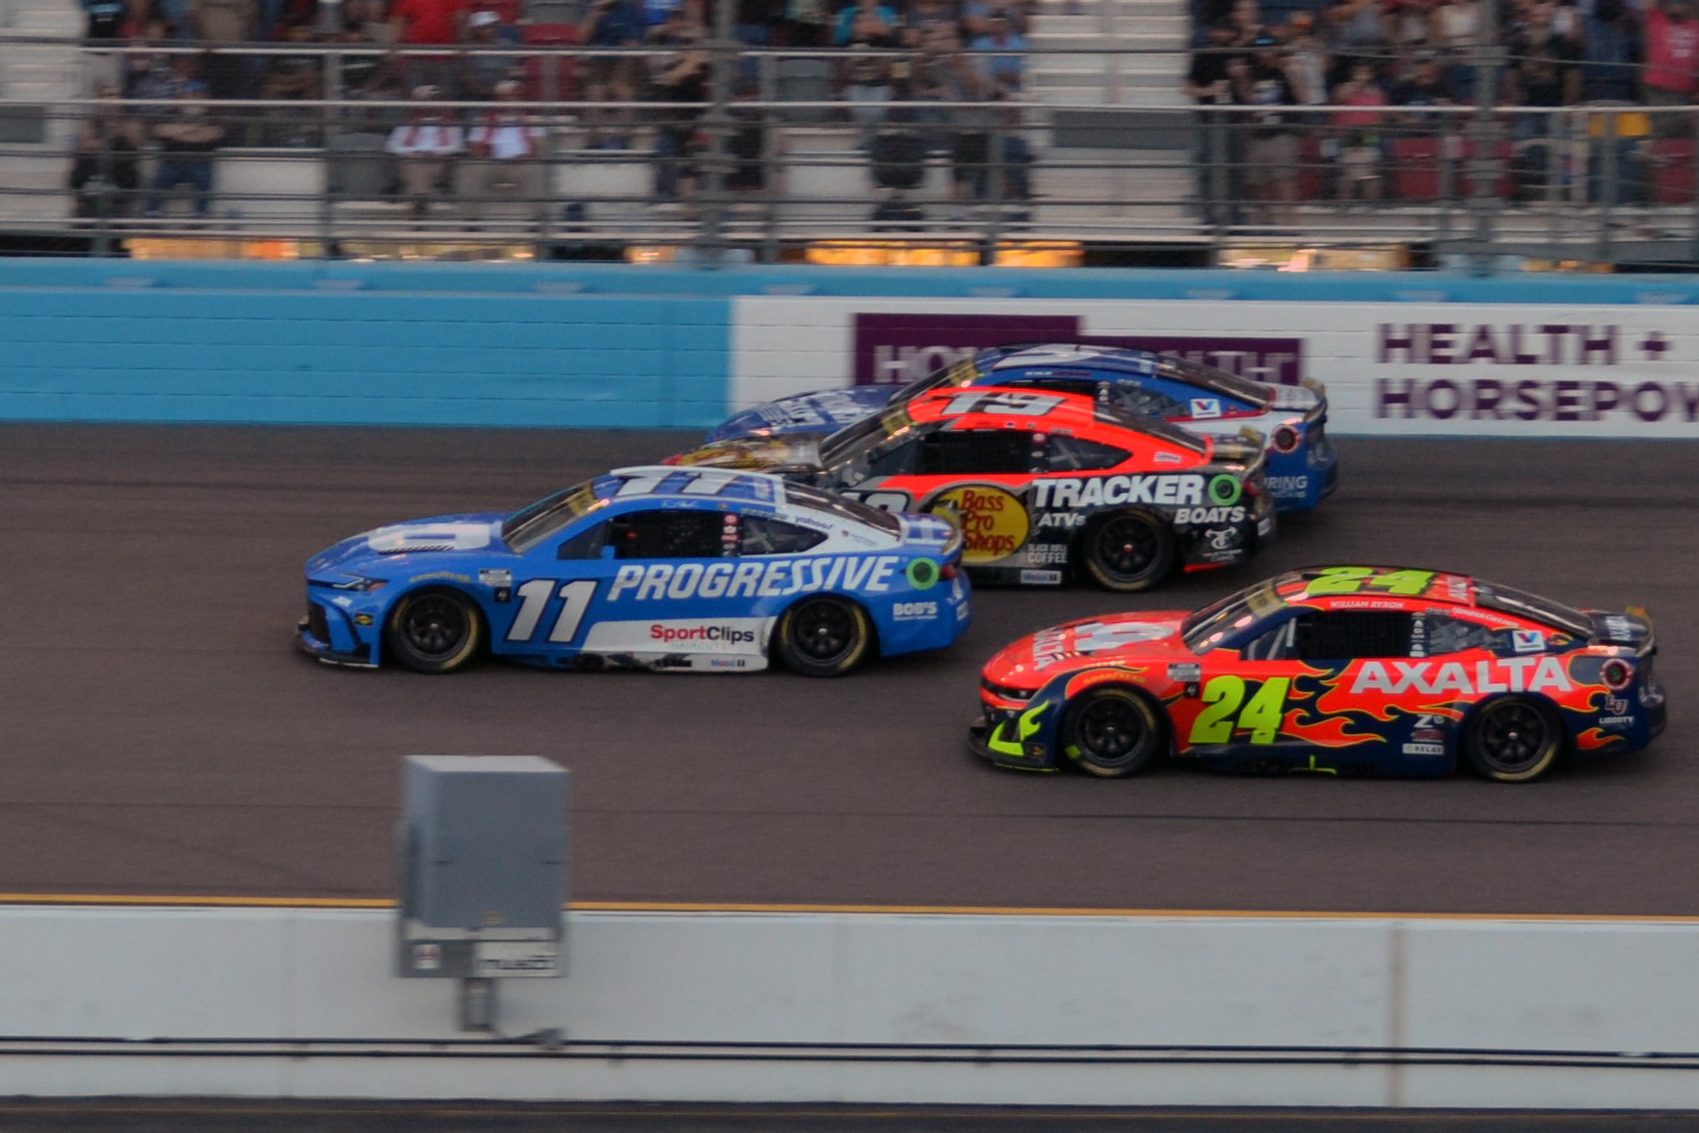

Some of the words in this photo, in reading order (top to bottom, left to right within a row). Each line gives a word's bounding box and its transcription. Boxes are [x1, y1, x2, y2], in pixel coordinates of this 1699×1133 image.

[1375, 323, 1620, 365] HEALTH
[960, 490, 1005, 511] Bass
[1031, 475, 1203, 508] TRACKER
[962, 508, 994, 531] Pro
[1038, 512, 1086, 527] ATVs
[1174, 507, 1245, 524] BOATS
[964, 529, 1015, 556] Shops
[606, 555, 899, 601] PROGRESSIVE
[1302, 566, 1437, 596] 24
[506, 580, 596, 642] 11
[650, 624, 755, 645] SportClips
[1350, 657, 1573, 694] AXALTA
[1188, 675, 1291, 745] 24
